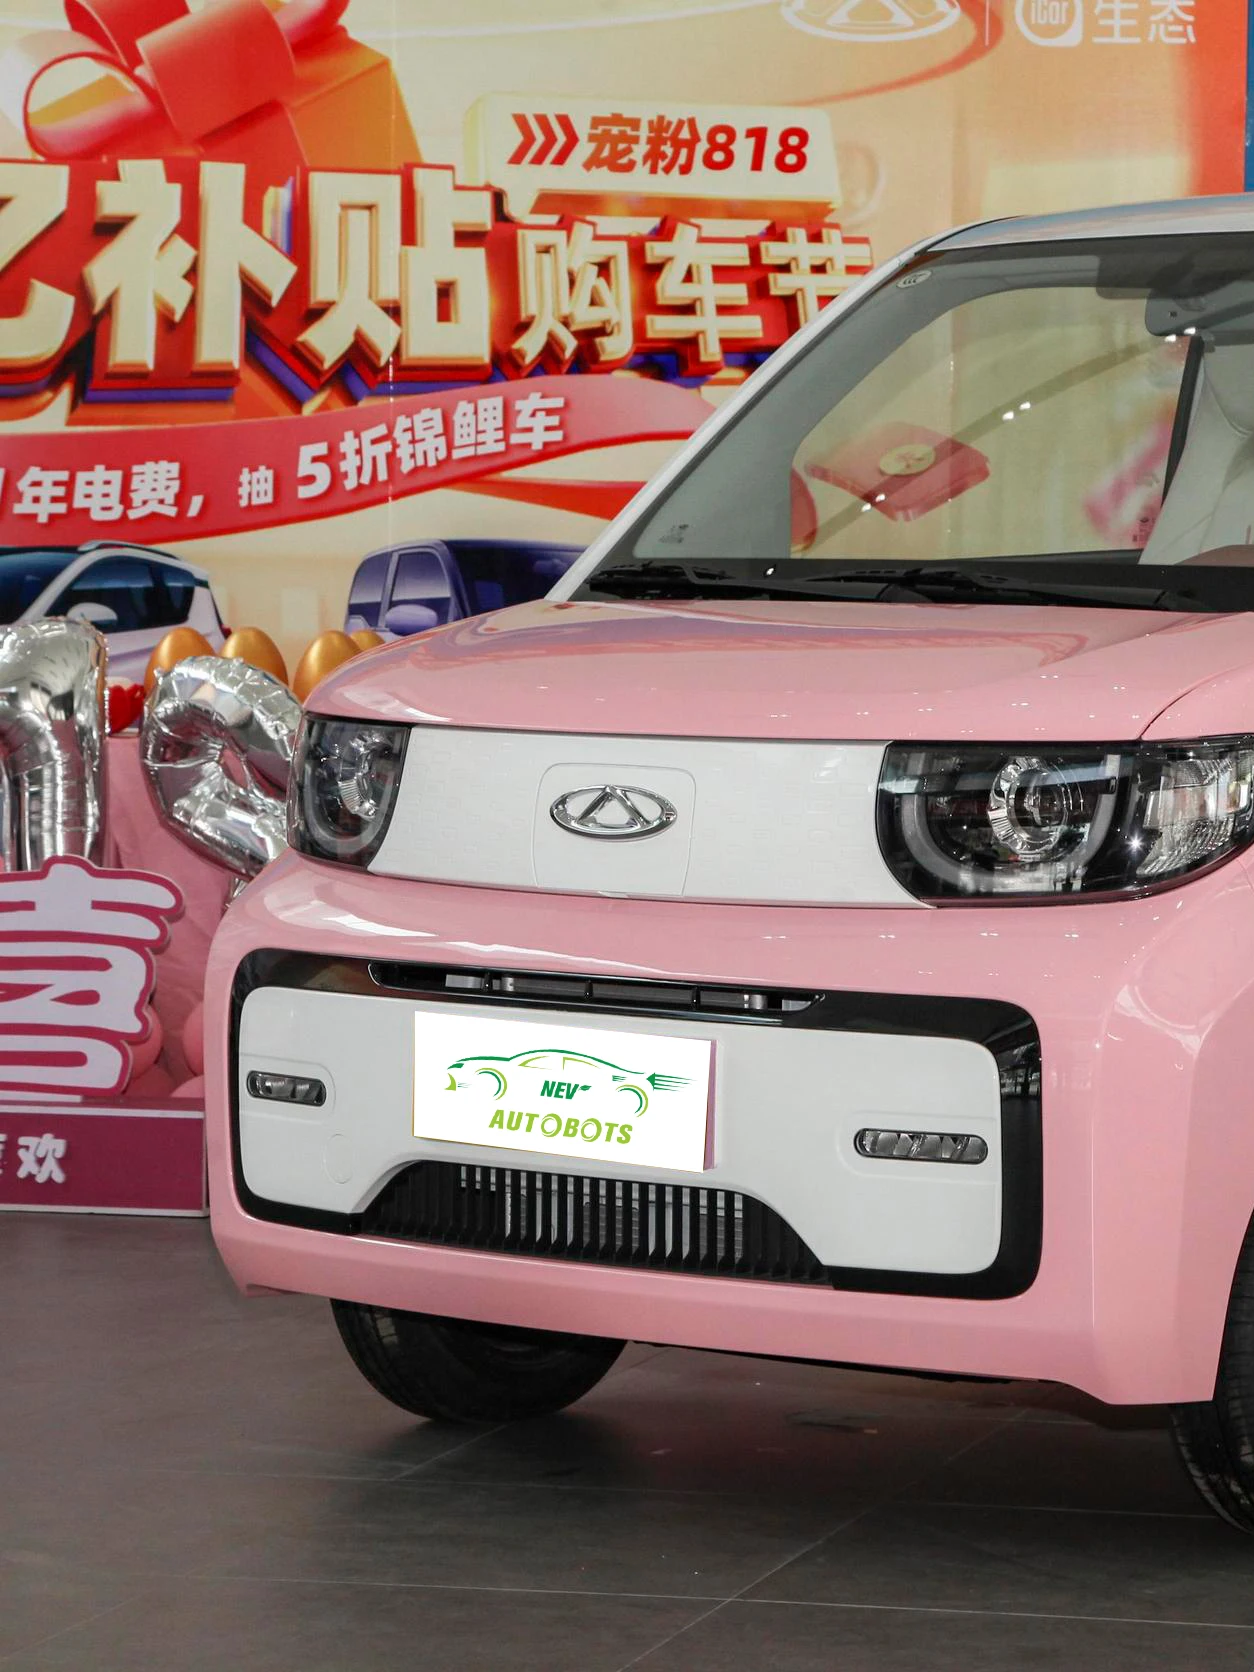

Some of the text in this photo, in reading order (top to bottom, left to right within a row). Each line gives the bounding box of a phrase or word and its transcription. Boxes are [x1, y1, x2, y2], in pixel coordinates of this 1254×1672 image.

[582, 112, 810, 176] 宠粉818
[238, 465, 274, 507] 抽
[297, 391, 565, 499] 5折锦鲤车
[0, 1132, 66, 1184] 欢
